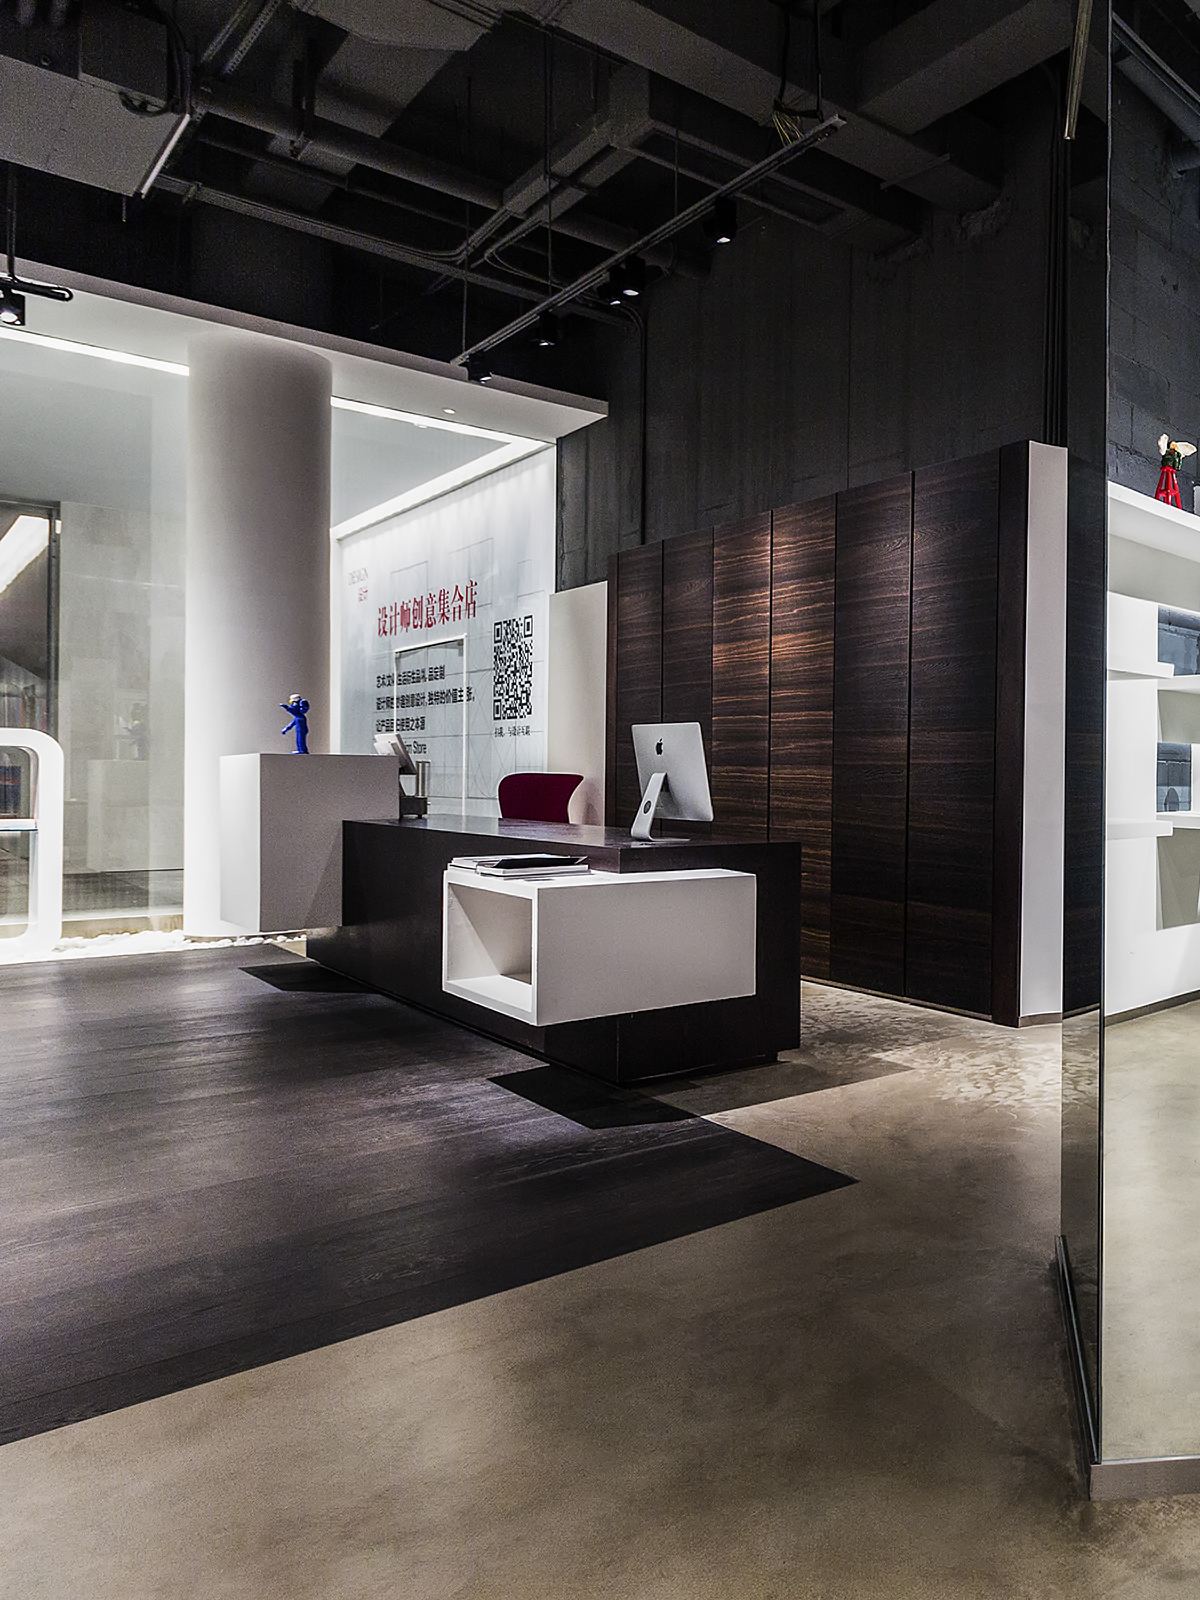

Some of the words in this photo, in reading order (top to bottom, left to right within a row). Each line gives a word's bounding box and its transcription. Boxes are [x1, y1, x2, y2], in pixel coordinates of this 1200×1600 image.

[377, 579, 478, 638] 设计师创意集合店
[413, 740, 427, 755] Store
